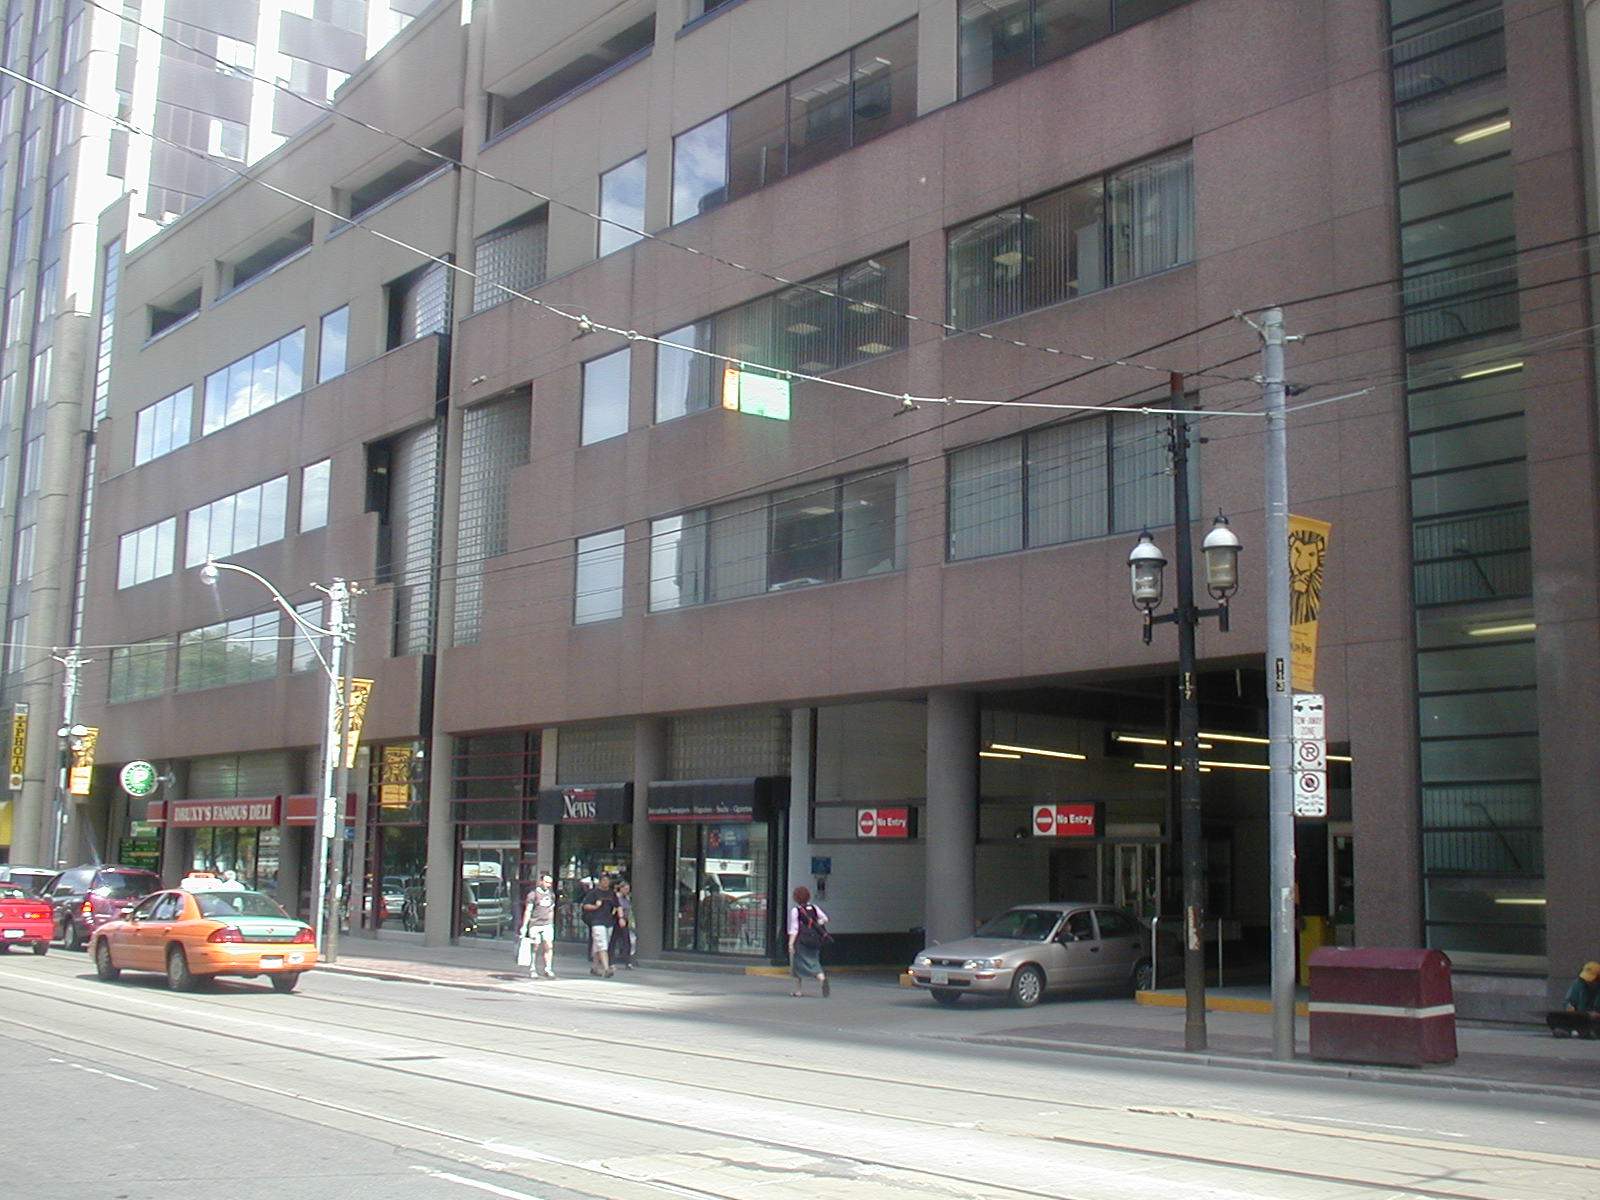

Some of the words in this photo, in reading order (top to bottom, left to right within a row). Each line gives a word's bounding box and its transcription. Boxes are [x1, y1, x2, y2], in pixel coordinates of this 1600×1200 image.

[12, 727, 25, 774] PHOTO
[213, 805, 248, 821] FAMOUS
[249, 804, 272, 820] DELI
[562, 795, 596, 818] News
[877, 817, 887, 826] No
[887, 817, 906, 828] Entry
[1056, 814, 1069, 825] No
[1069, 814, 1093, 826] Entry
